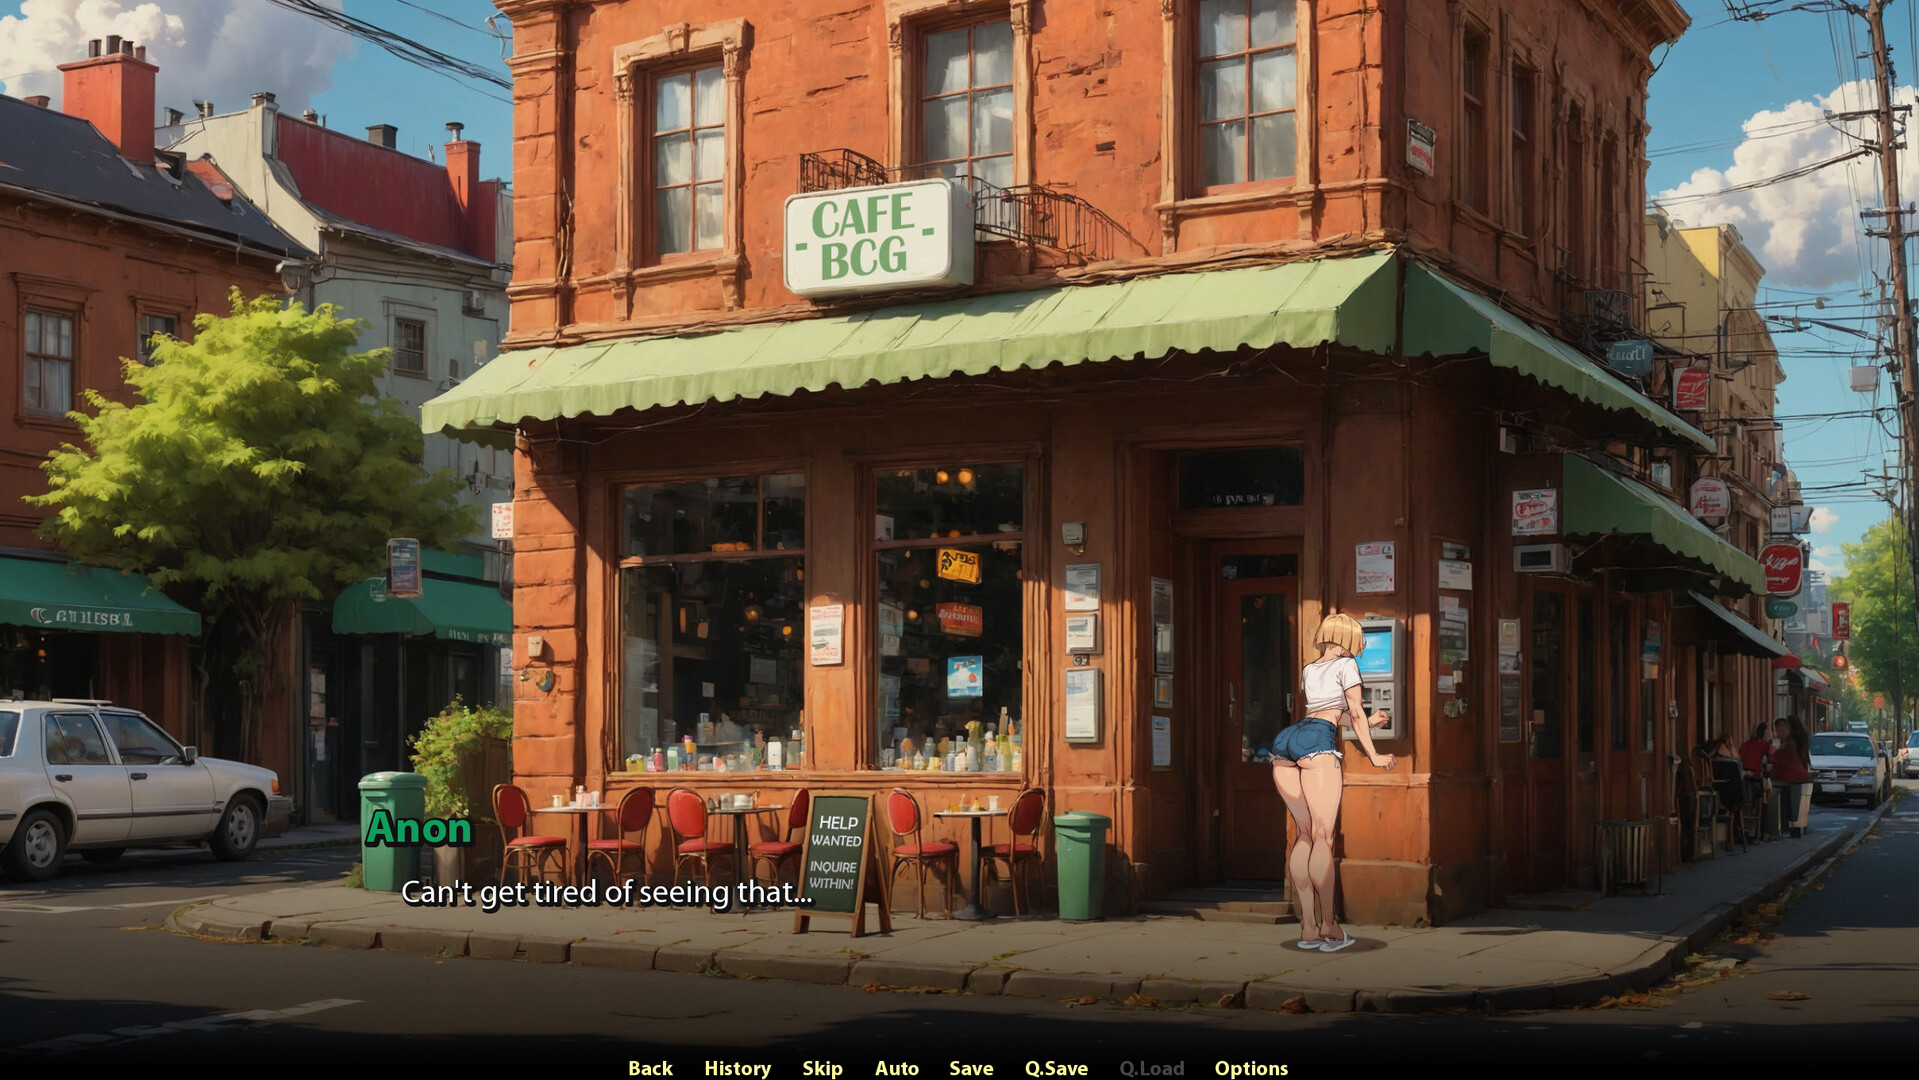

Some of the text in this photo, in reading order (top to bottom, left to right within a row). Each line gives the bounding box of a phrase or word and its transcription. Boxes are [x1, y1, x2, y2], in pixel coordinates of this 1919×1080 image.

[812, 191, 915, 239] CAFE
[821, 235, 907, 281] BCG
[819, 815, 859, 831] HELP
[811, 834, 862, 847] WANTED
[810, 860, 857, 874] INQUIRE
[809, 877, 854, 890] WITHIN!
